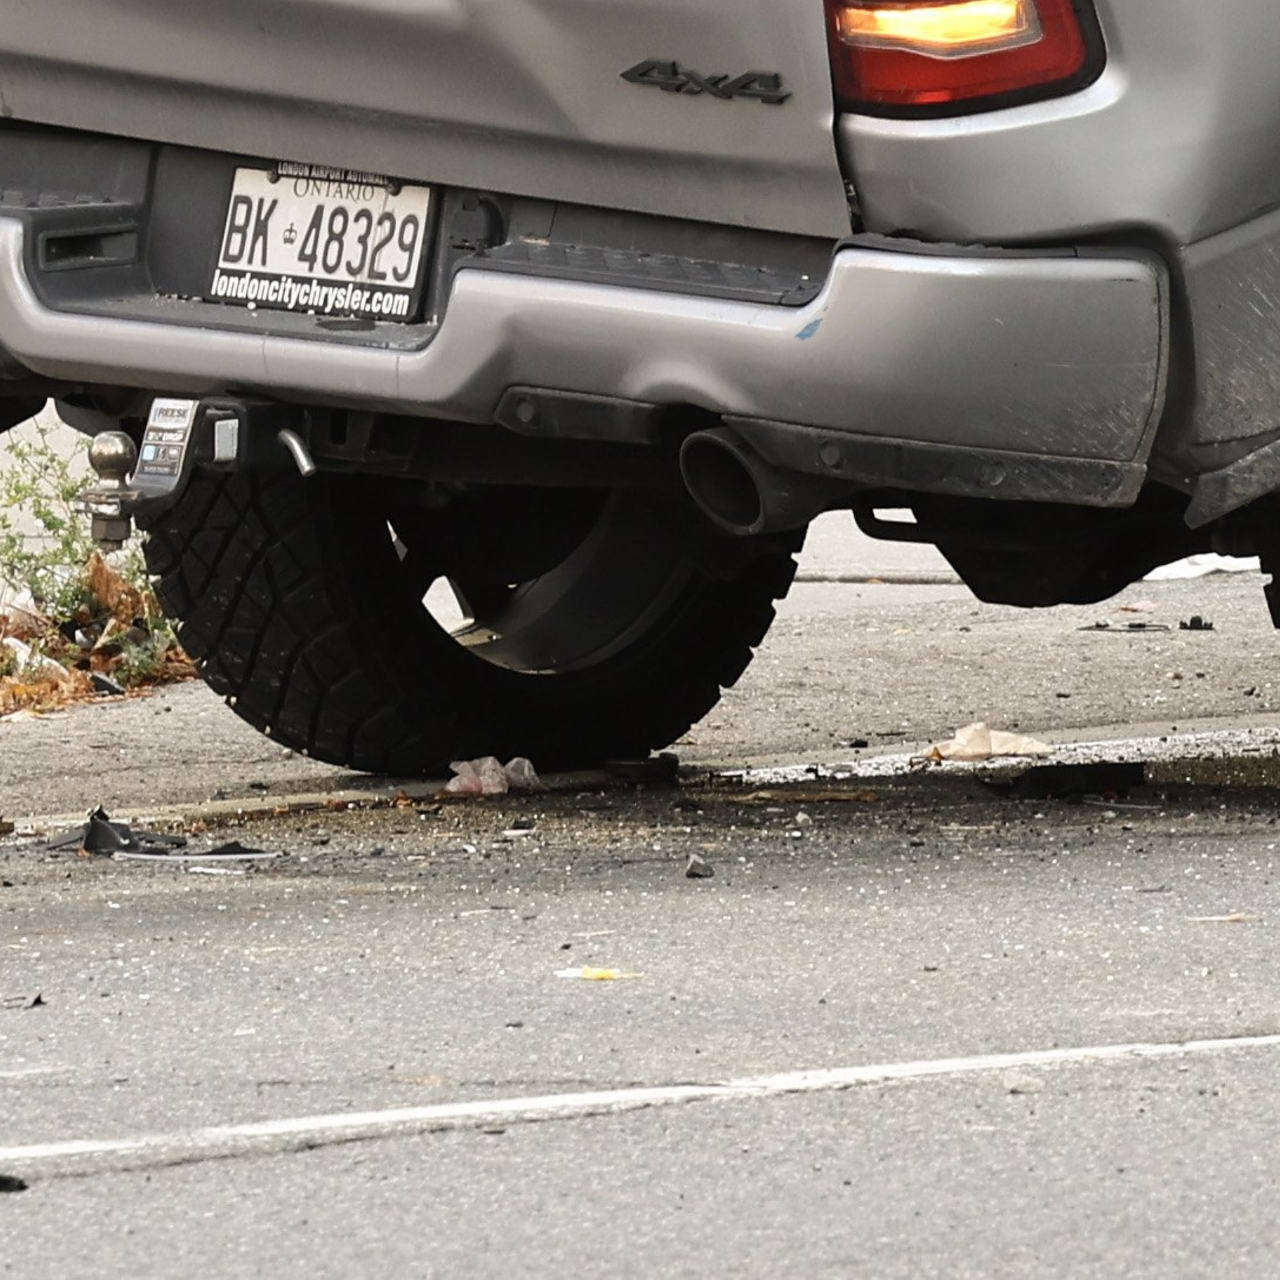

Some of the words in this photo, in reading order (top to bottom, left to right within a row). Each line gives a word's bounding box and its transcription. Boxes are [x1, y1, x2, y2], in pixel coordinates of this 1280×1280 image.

[277, 161, 310, 177] LONDON
[311, 165, 346, 181] AIRPORT
[293, 178, 376, 204] ONTARIO
[222, 194, 278, 267] BK
[297, 203, 420, 283] 48329
[210, 269, 410, 316] londoncitychrysler.com
[159, 407, 189, 418] REESE
